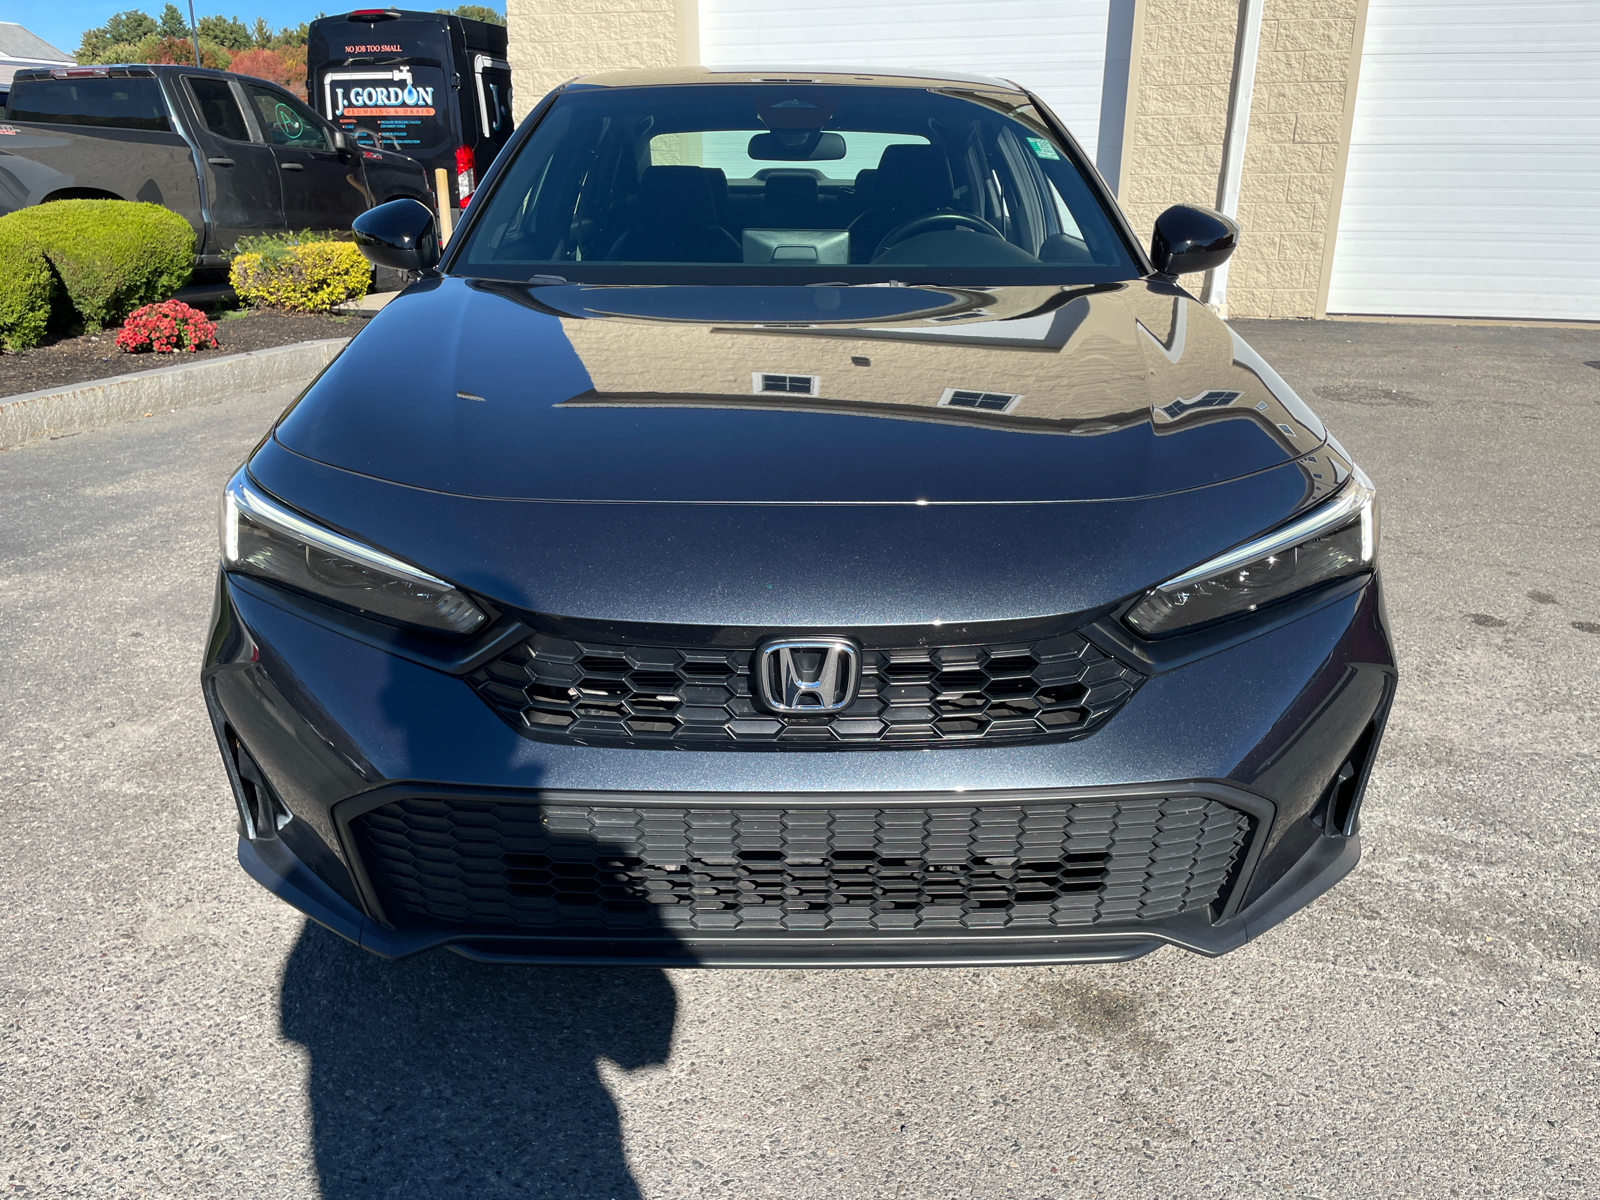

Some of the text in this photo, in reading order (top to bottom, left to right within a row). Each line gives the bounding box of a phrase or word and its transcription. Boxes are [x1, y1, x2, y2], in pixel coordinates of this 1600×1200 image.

[345, 44, 402, 54] NO JOB TOO SMALL
[335, 86, 434, 116] J. GORDON
